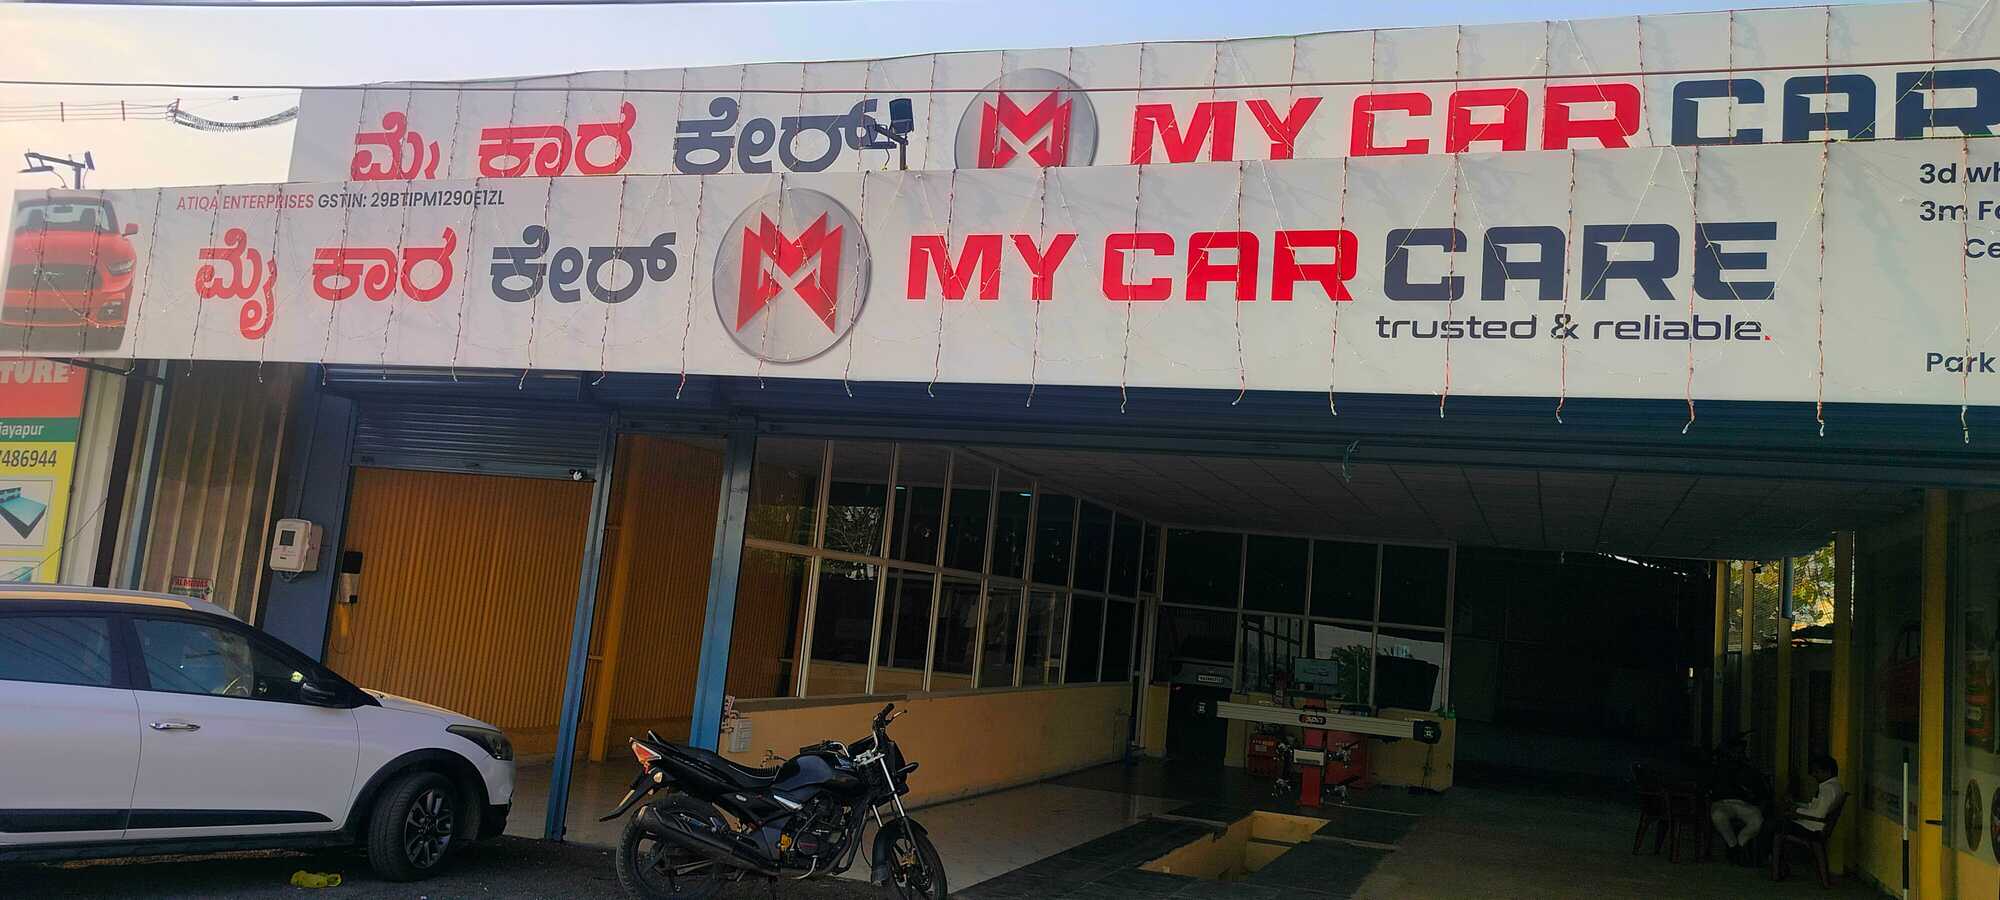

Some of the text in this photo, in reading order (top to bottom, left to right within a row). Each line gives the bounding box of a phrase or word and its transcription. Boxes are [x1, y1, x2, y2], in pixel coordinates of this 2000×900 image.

[1132, 96, 1322, 164] MY
[1350, 83, 1641, 157] CAR
[1919, 162, 1957, 184] 3d
[176, 195, 220, 211] ATIQA
[222, 193, 315, 210] ENTERPRISES
[318, 192, 367, 208] GSTIN:
[1919, 200, 1968, 222] 3m
[1966, 238, 2000, 259] Ce
[907, 221, 1778, 302] MY CAR CARE
[194, 224, 678, 340] ಮೈ ಕಾರ ಕೇರ್
[1376, 314, 1537, 340] trusted
[1550, 313, 1580, 340] &
[1926, 351, 1997, 373] Park
[0, 449, 57, 468] 486944
